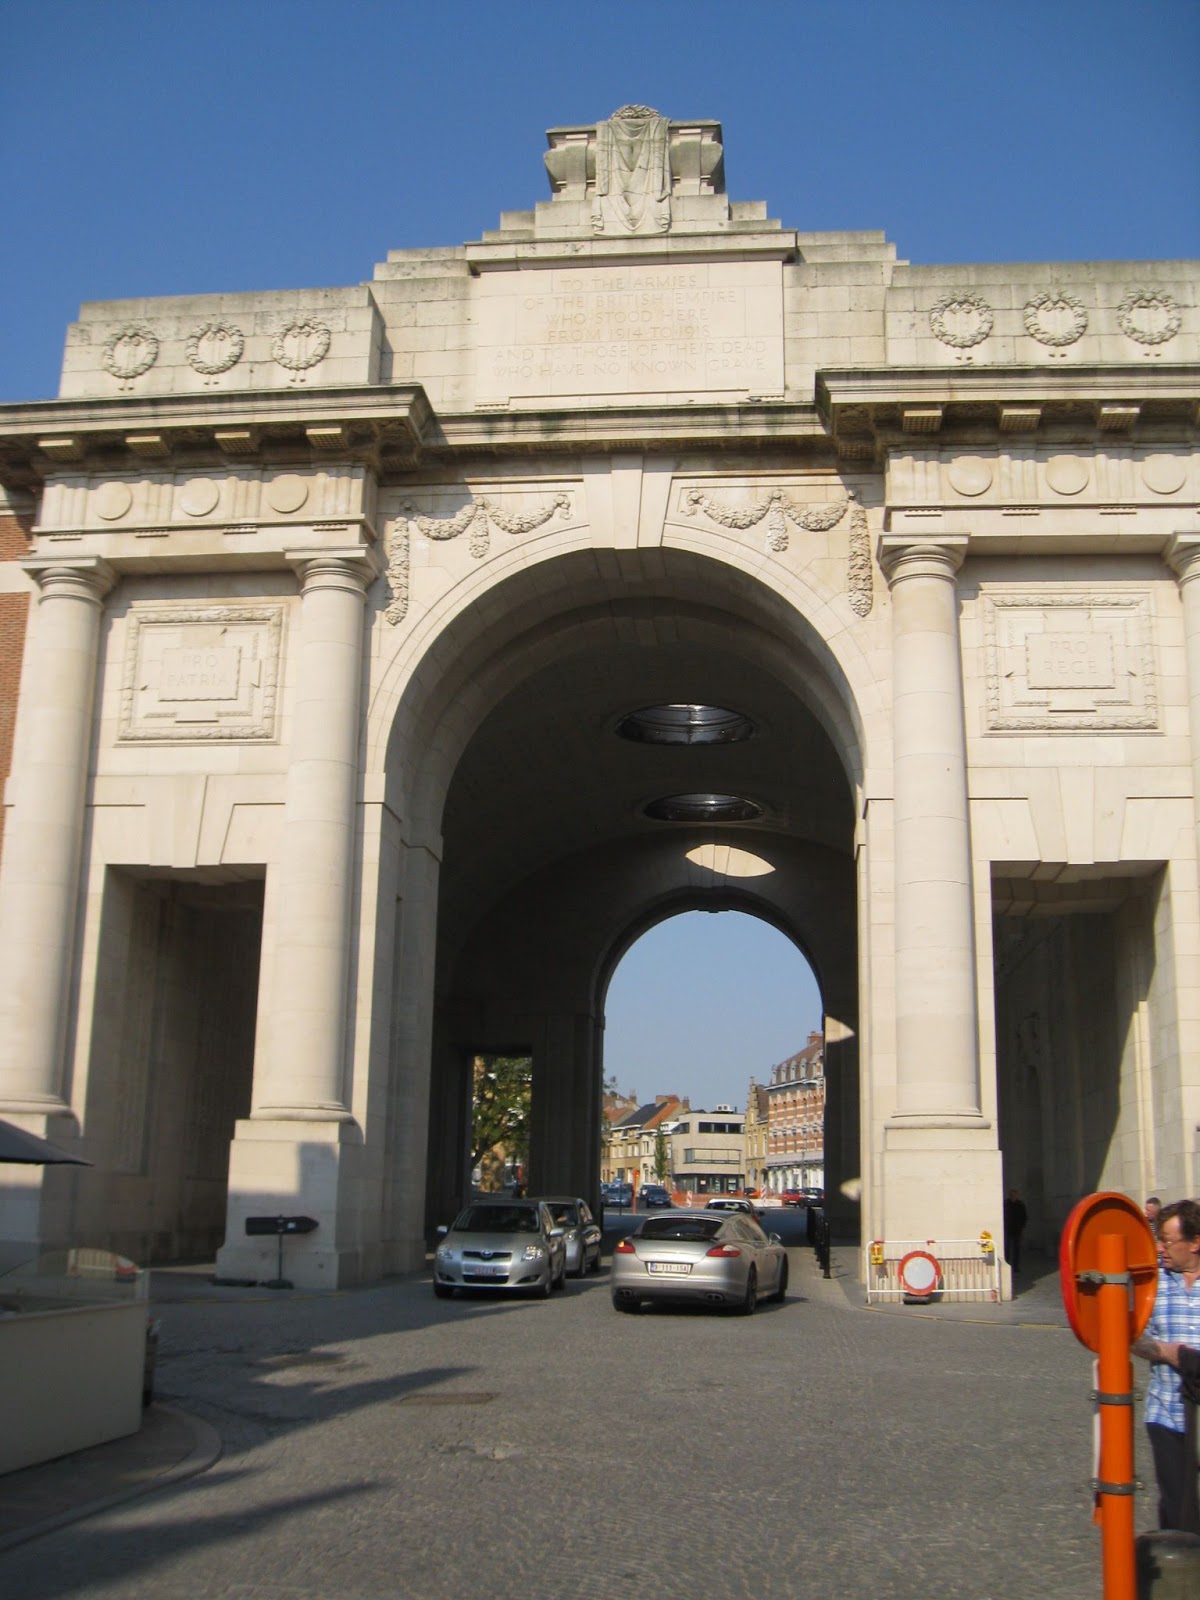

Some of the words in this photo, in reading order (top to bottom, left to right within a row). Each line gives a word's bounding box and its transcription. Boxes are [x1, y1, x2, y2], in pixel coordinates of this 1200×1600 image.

[560, 278, 584, 292] TO
[592, 276, 625, 291] THE
[633, 274, 697, 289] ARMIES
[523, 297, 545, 311] OF
[552, 295, 585, 309] THE
[596, 293, 664, 308] BRITISH
[675, 290, 737, 304] EMPIRE
[547, 312, 586, 327] WHO
[596, 309, 653, 324] STOOD
[663, 307, 710, 322] HERE
[547, 329, 601, 344] FROM
[609, 327, 643, 341] 1914
[650, 326, 672, 340] TO
[678, 324, 711, 338] 1918
[494, 348, 535, 362] AND
[541, 347, 561, 361] TO
[572, 344, 630, 359] THOSE
[636, 344, 658, 357] OF
[666, 342, 714, 356] THEIR
[721, 340, 767, 354] DEAD
[494, 366, 533, 380] WHO
[538, 363, 584, 377] HAVE
[593, 362, 621, 376] NO
[629, 359, 697, 374] KNOWN
[707, 358, 766, 372] GRAVE
